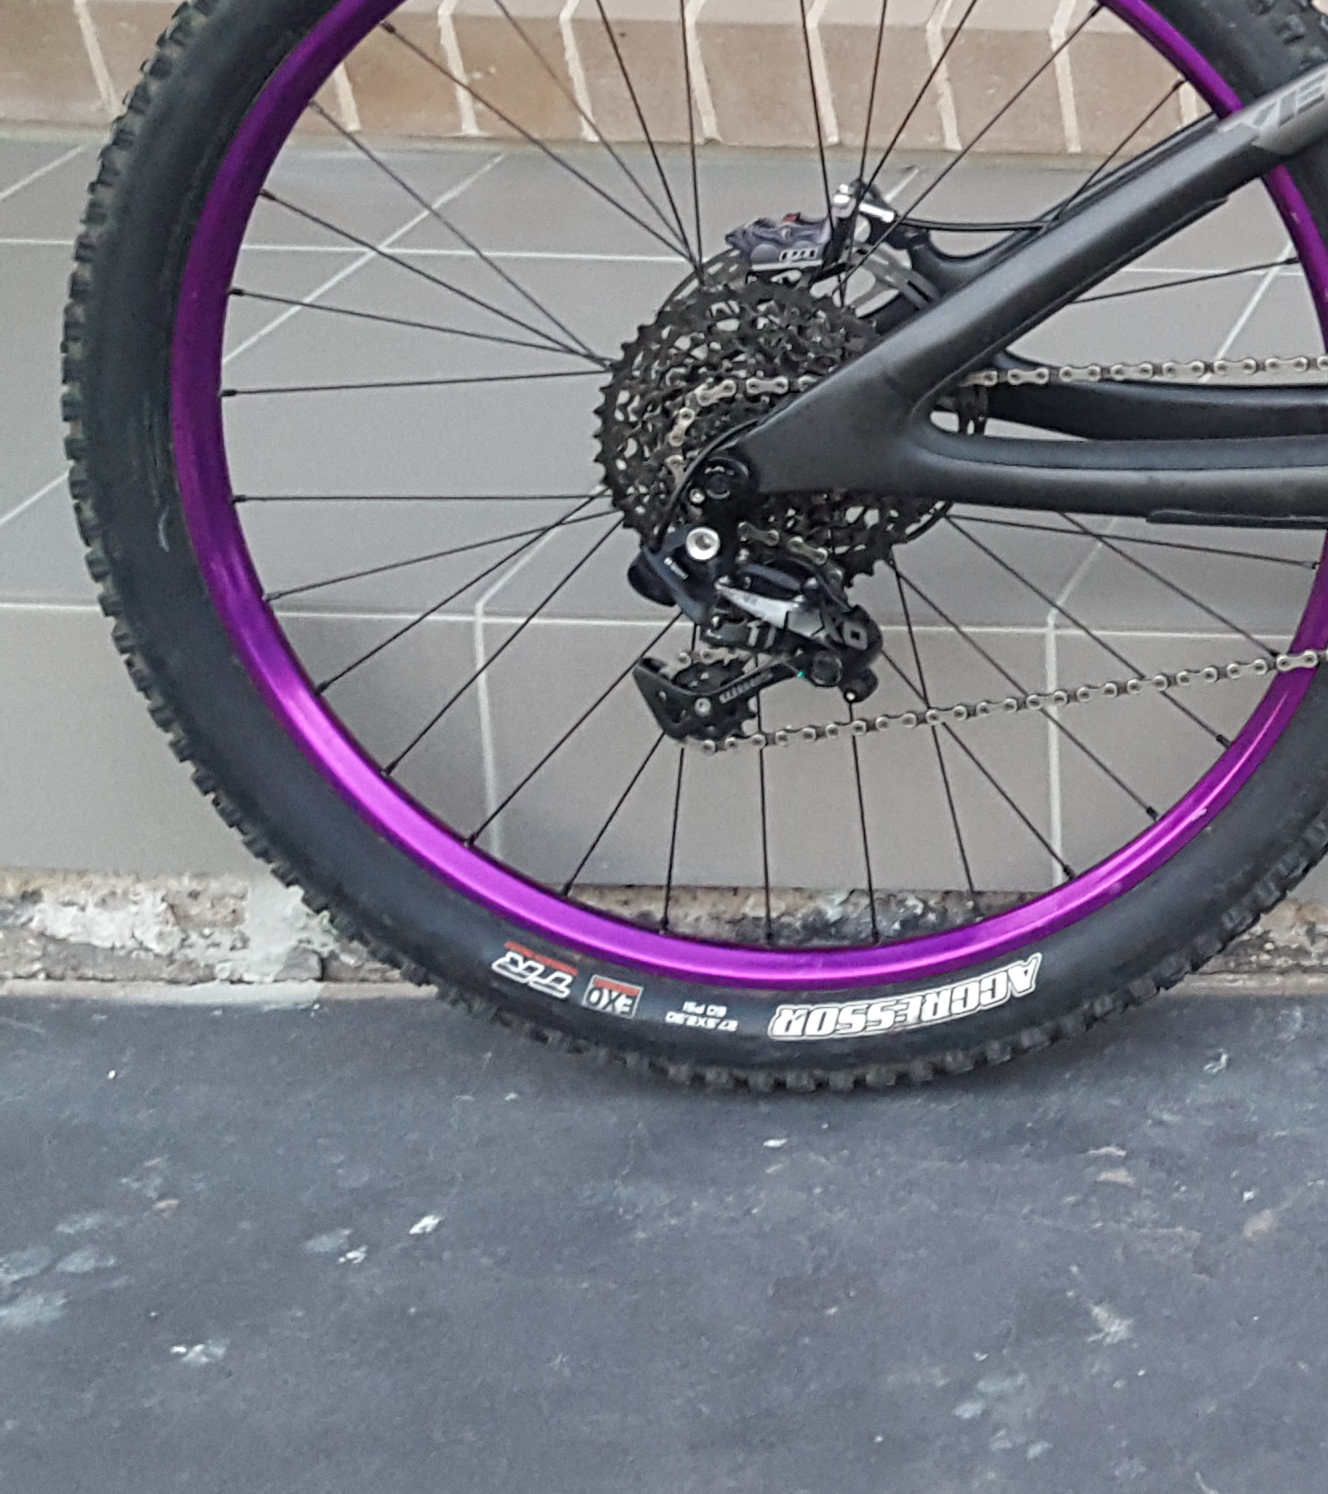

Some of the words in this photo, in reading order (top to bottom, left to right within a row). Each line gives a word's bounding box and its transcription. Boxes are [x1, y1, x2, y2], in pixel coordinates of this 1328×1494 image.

[491, 950, 574, 999] TR
[768, 952, 1043, 1041] AGGRESSOR
[583, 982, 639, 1018] EXO
